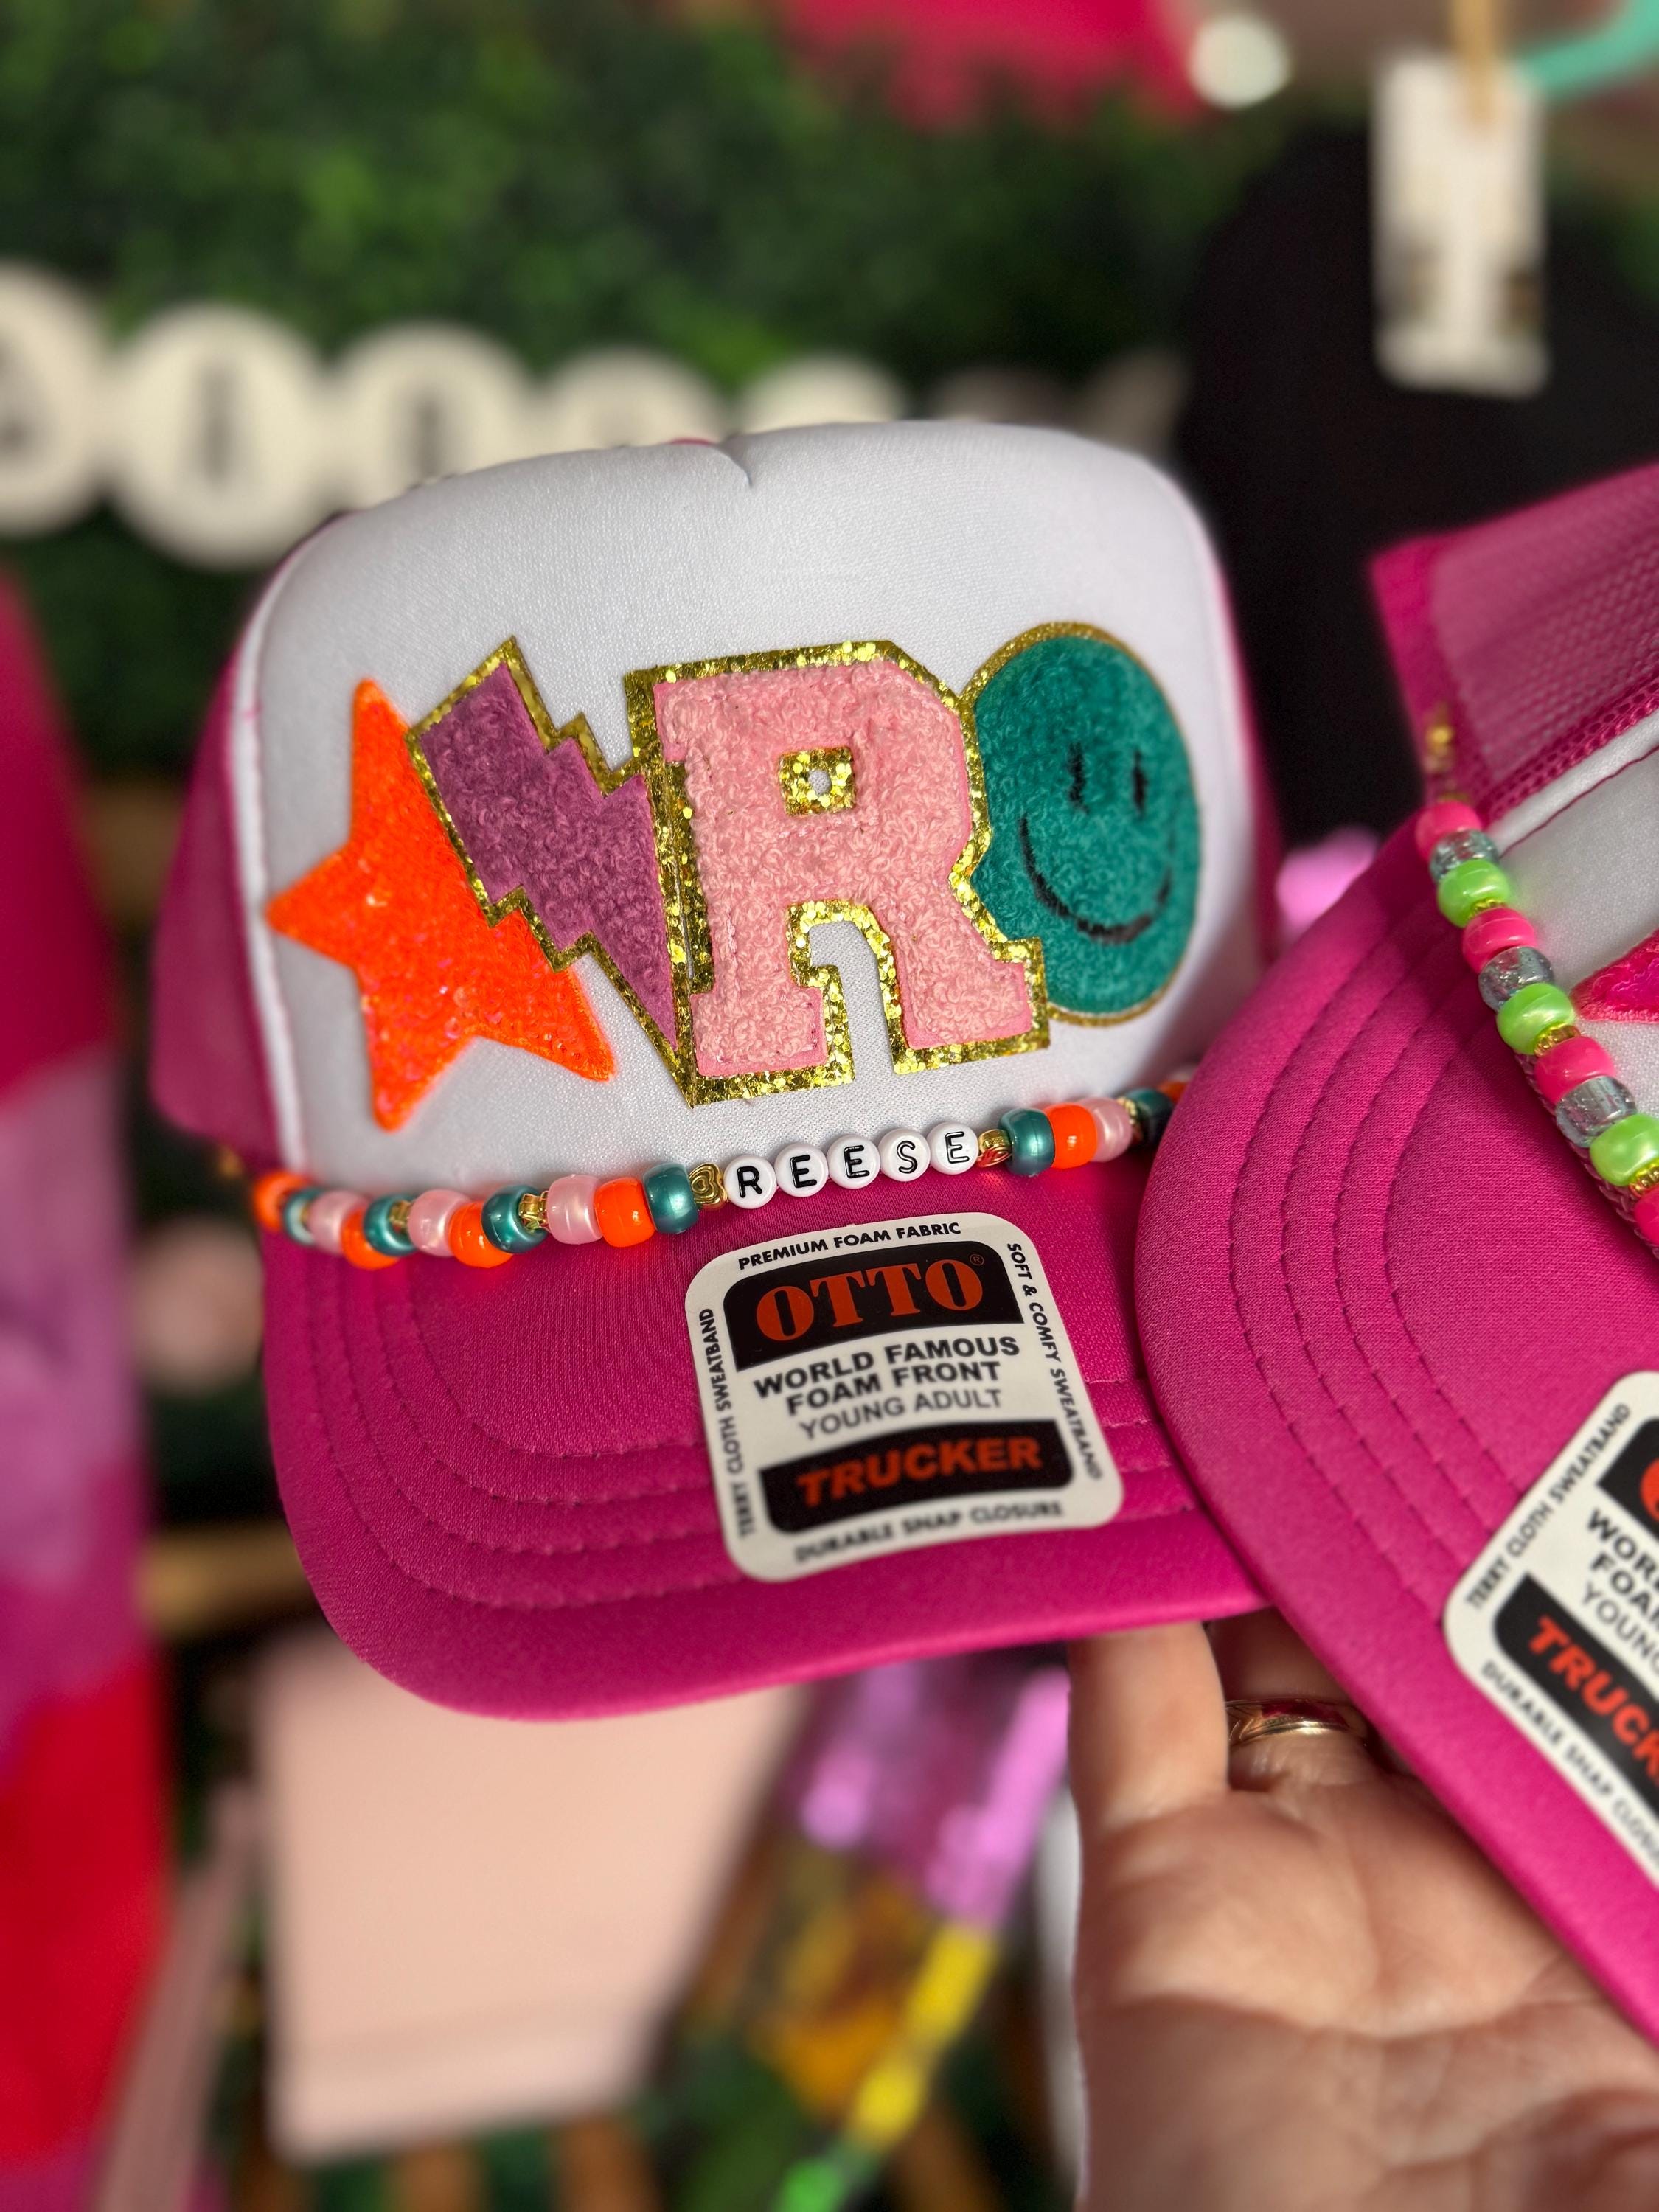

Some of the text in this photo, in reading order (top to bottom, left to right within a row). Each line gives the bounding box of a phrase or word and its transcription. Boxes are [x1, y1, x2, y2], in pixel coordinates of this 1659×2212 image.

[641, 653, 1038, 1085] R
[737, 1131, 970, 1198] REESE
[738, 1222, 961, 1270] PREMIUM FOAM FABRIC
[1007, 1243, 1032, 1280] SOFT
[1022, 1284, 1037, 1298] &
[698, 1308, 731, 1412] SWEATBAND
[1029, 1301, 1062, 1363] COMFY
[753, 1336, 1020, 1399] WORLD FAMOUS
[786, 1360, 1001, 1416] FOAM FRONT
[718, 1416, 745, 1474] CLOTH
[799, 1388, 1002, 1440] YOUNG ADULT
[796, 1435, 1043, 1509] TRUCKER
[1588, 1507, 1659, 1592] WOR
